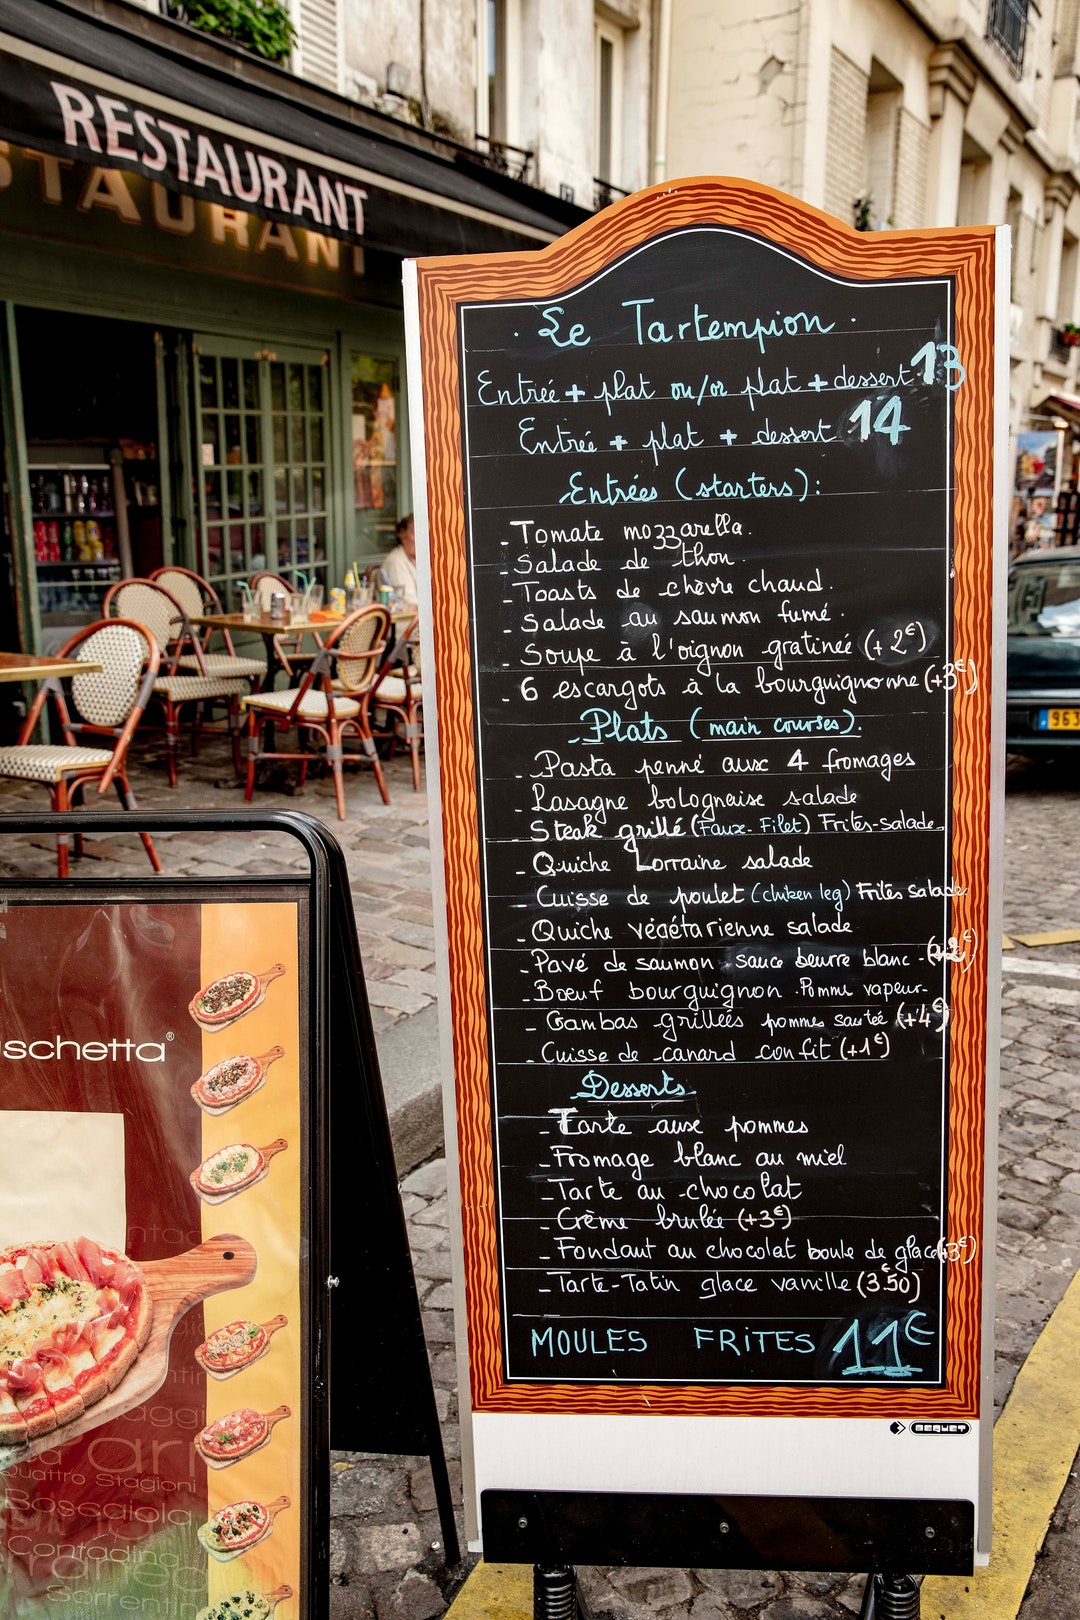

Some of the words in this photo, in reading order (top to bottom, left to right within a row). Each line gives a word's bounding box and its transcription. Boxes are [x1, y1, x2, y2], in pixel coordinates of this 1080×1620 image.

[49, 80, 368, 236] RESTAURANT
[537, 306, 591, 347] Le
[621, 298, 835, 353] Tartempion
[477, 370, 560, 405] Entrée
[594, 370, 655, 416] plat
[741, 367, 801, 411] plat
[834, 364, 914, 388] dessert
[910, 341, 966, 391] 13
[519, 417, 597, 454] Entrée
[642, 421, 704, 466] plat
[752, 418, 837, 445] dessert
[848, 395, 911, 445] 14
[559, 472, 658, 505] Entrées
[510, 520, 604, 543] Tomate
[513, 548, 601, 573] Salade
[620, 548, 649, 570] de
[512, 579, 597, 602] Toasts
[616, 578, 640, 599] de
[659, 574, 733, 596] chèvre
[521, 608, 605, 632] Salade
[622, 611, 658, 627] au
[673, 609, 761, 625] saumon
[520, 643, 601, 676] Soupe
[617, 641, 636, 661] à
[652, 633, 744, 677] l'oignon
[520, 676, 539, 701] 6
[553, 673, 666, 710] escargots
[682, 679, 703, 696] à
[716, 673, 740, 694] la
[755, 666, 919, 704] bourguignonne
[568, 708, 668, 743] Plats
[690, 707, 761, 739] (main
[530, 750, 616, 778] Pasta
[635, 754, 704, 784] penné
[722, 757, 768, 772] aux
[787, 748, 809, 771] 4
[822, 748, 916, 781] fromages
[531, 783, 628, 824] Lasagne
[648, 784, 765, 820] bolognaise
[783, 784, 858, 806] salade
[530, 814, 602, 841] Steak
[615, 816, 686, 852] grillé
[532, 851, 611, 876] Quiche
[636, 848, 727, 871] Lorraine
[742, 845, 813, 869] salade
[536, 885, 610, 907] Cuisse
[627, 885, 650, 905] de
[670, 883, 744, 913] poulet
[819, 879, 851, 912] leg)
[532, 917, 612, 942] Quiche
[531, 949, 589, 974] Pavé
[604, 950, 628, 972] de
[635, 957, 715, 971] saumon
[735, 954, 784, 969] sauce
[794, 947, 851, 968] beurre
[629, 981, 782, 1012] bourguignon
[546, 1010, 638, 1031] Gambas
[541, 1041, 609, 1063] Cuisse
[618, 1041, 639, 1062] de
[653, 1040, 736, 1062] canard
[570, 1070, 697, 1099] Desserts
[548, 1107, 632, 1135] Tarte
[648, 1118, 703, 1134] aux
[725, 1116, 809, 1142] pommes
[550, 1145, 654, 1180] Fromage
[674, 1141, 741, 1167] blanc
[756, 1151, 784, 1166] au
[797, 1144, 847, 1166] miel
[547, 1176, 622, 1200] Tarte
[638, 1184, 665, 1200] au
[557, 1207, 628, 1230] Crème
[553, 1237, 656, 1259] Fondant
[668, 1244, 697, 1259] au
[706, 1237, 794, 1259] chocolat
[807, 1239, 854, 1260] boule
[865, 1239, 886, 1259] de
[699, 1271, 757, 1299] glace
[771, 1271, 852, 1292] vanille
[531, 1327, 647, 1357] MOULES
[96, 1473, 196, 1493] Stagioni
[5, 1488, 192, 1526] Boscaiola
[8, 1535, 179, 1567] Contadina
